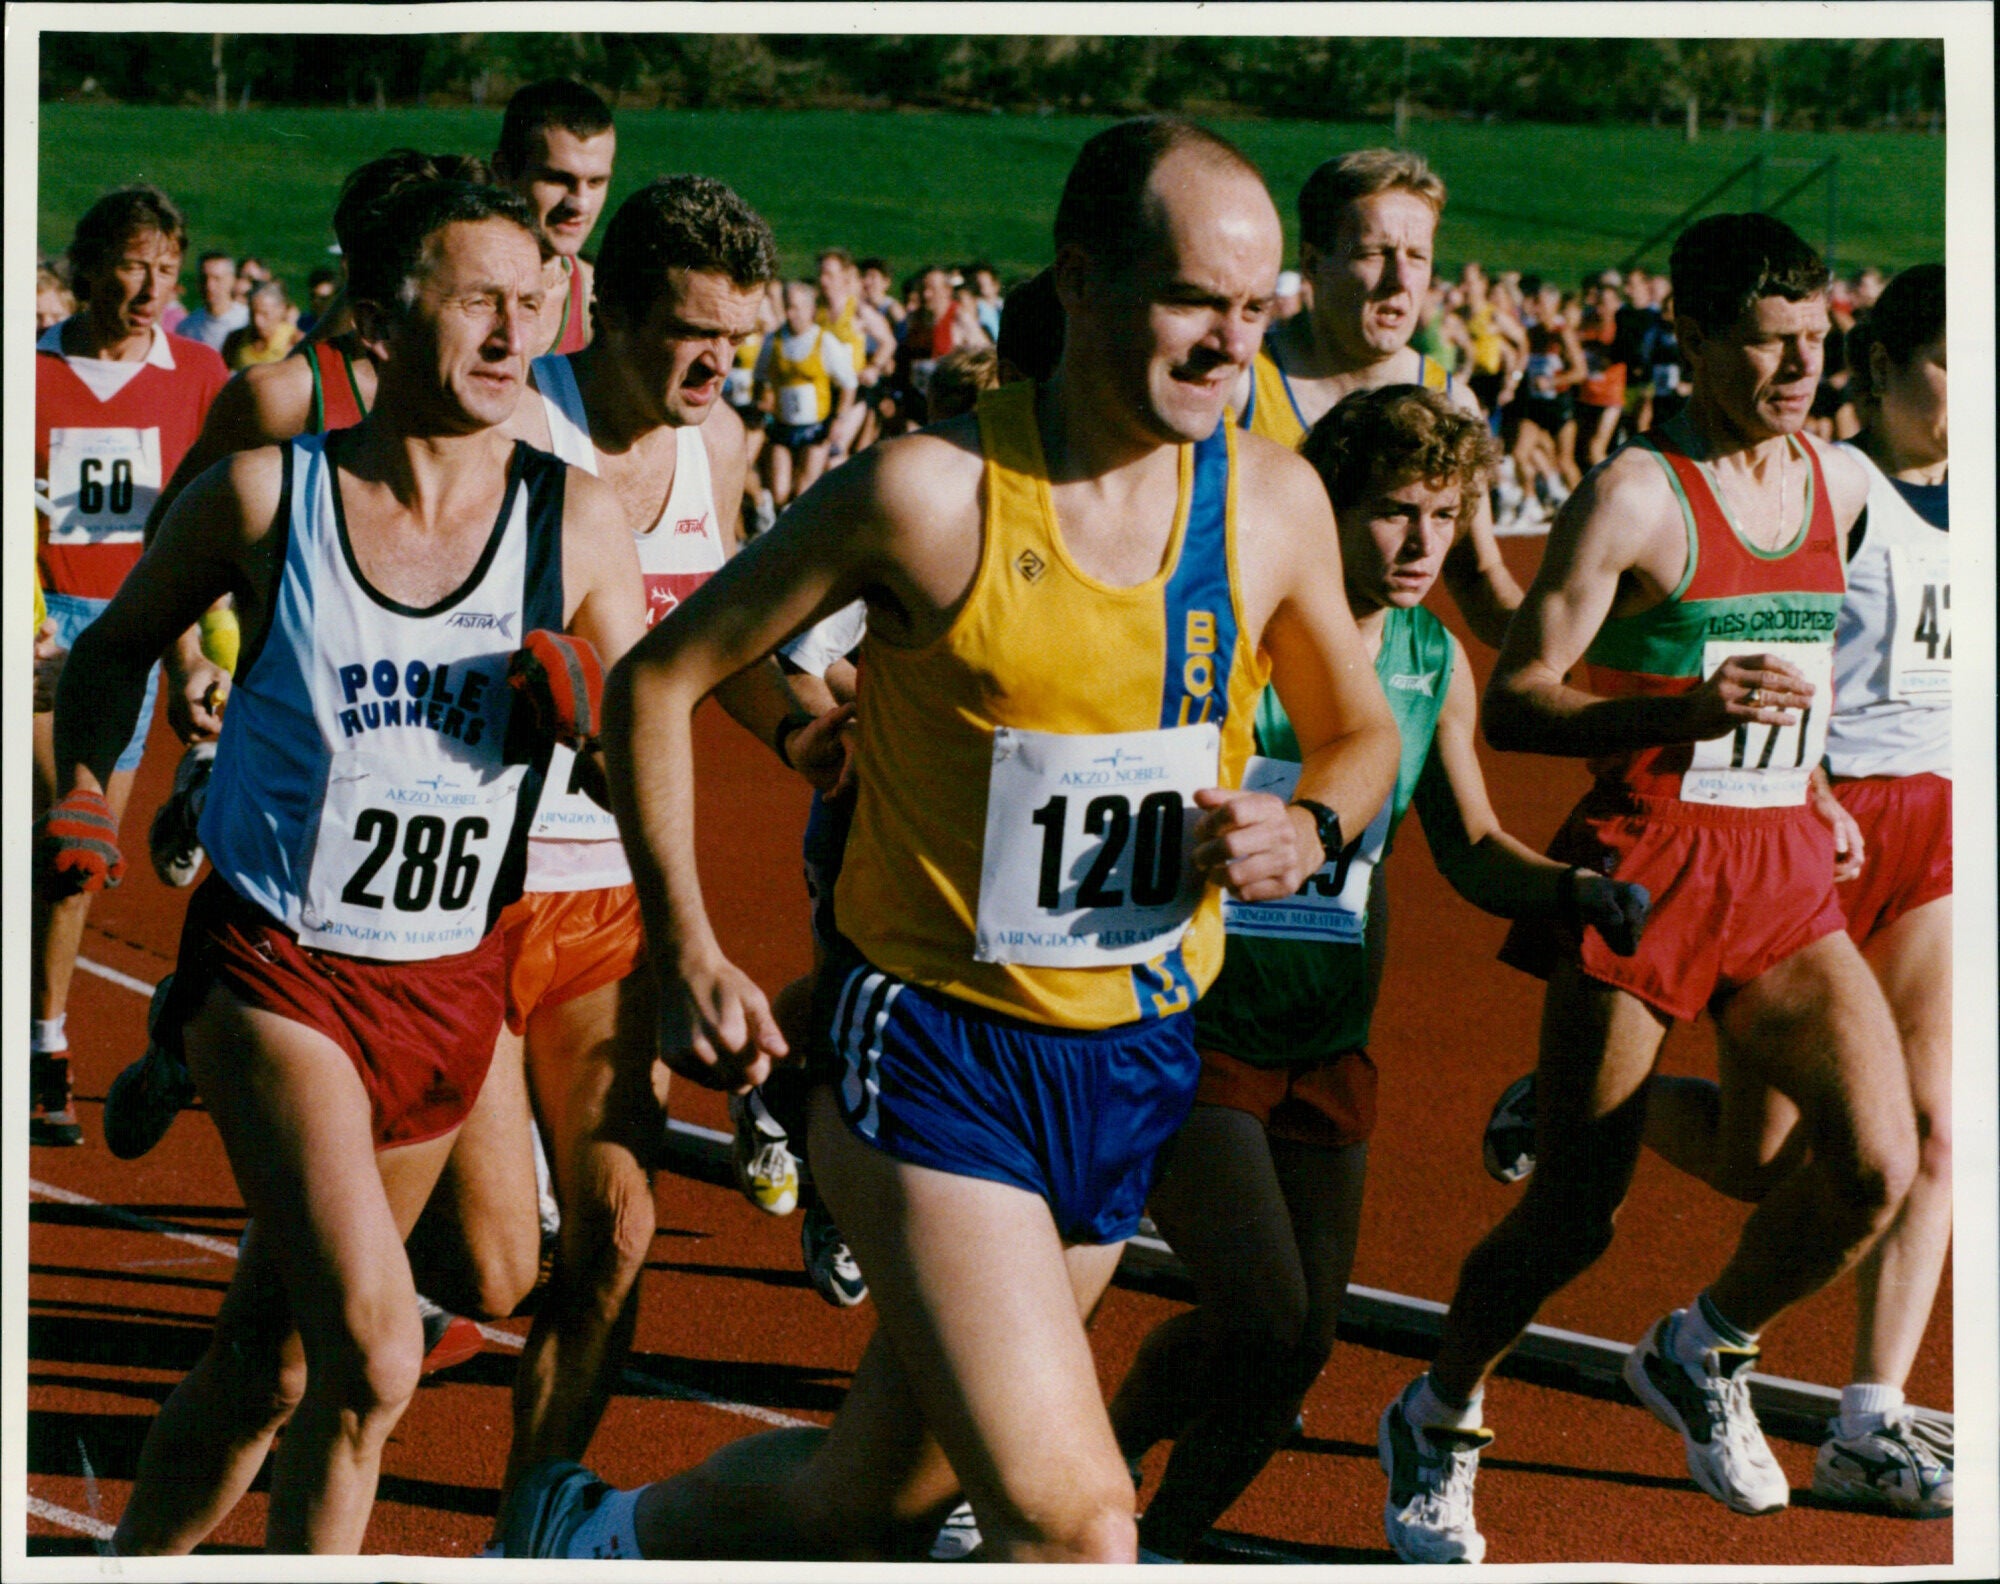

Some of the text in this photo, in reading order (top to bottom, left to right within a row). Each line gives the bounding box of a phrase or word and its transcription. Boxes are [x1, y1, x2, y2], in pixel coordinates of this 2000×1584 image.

[79, 458, 133, 514] 60
[1709, 613, 1746, 635] LES
[339, 659, 490, 714] POOLE
[339, 700, 486, 746] RUNNERS
[1059, 766, 1168, 785] AKZO NOBEL
[385, 787, 479, 806] AKZO NOBEL
[341, 808, 490, 912] 286
[1033, 791, 1184, 909] 120
[404, 925, 476, 945] MARATHON
[998, 930, 1089, 948] ABINGDON
